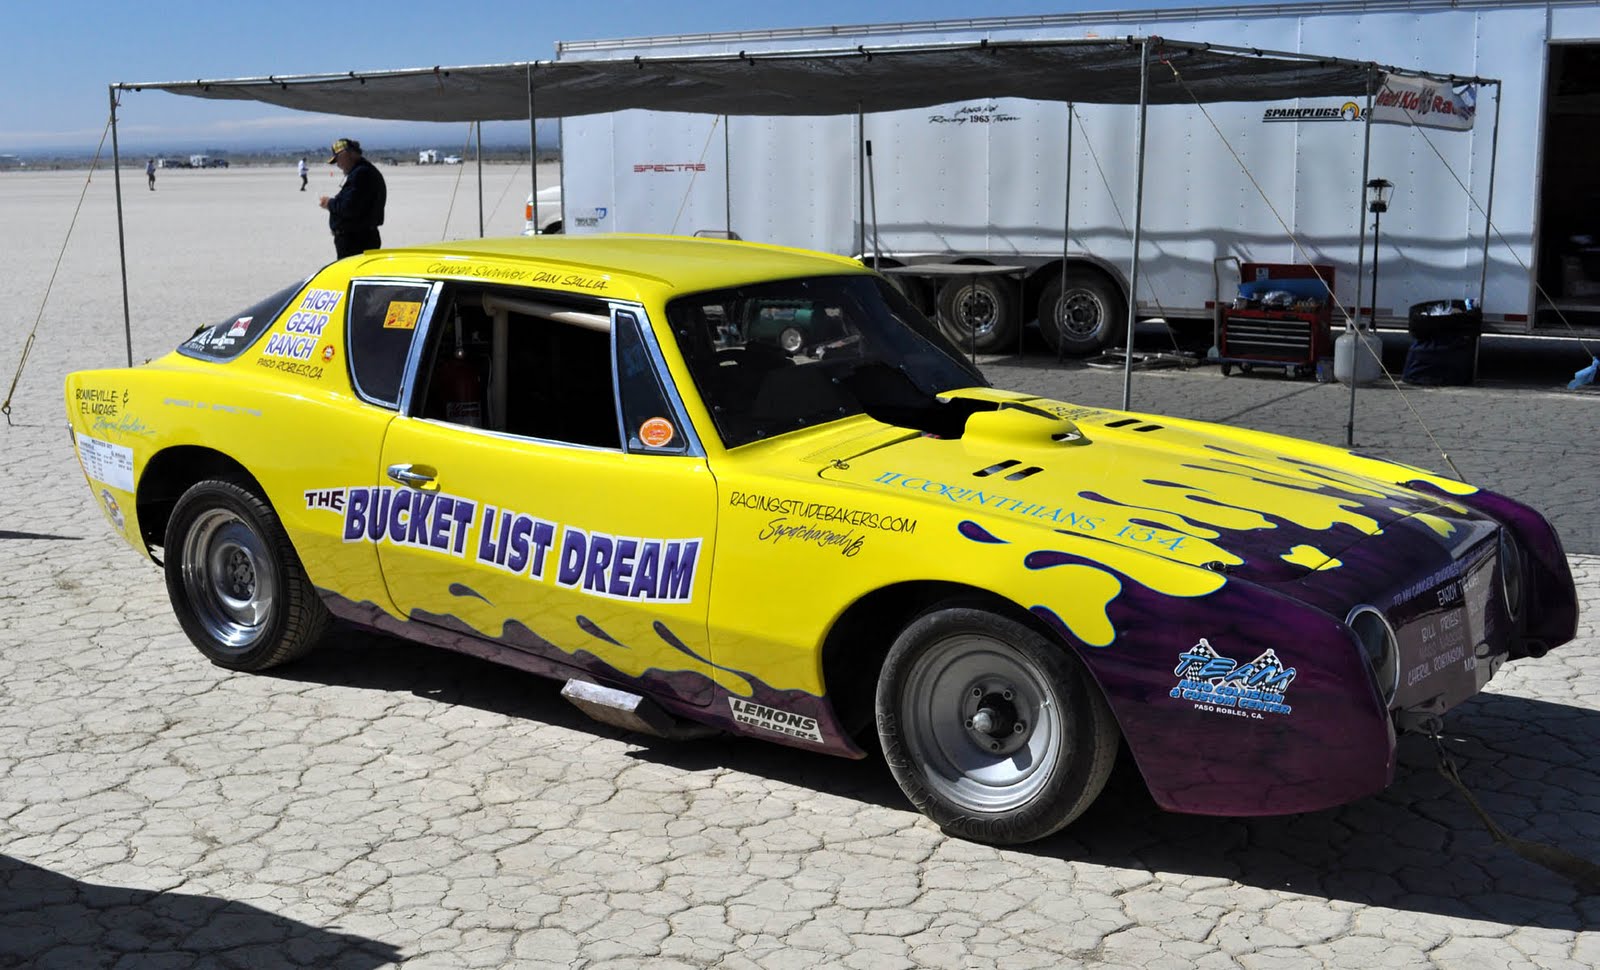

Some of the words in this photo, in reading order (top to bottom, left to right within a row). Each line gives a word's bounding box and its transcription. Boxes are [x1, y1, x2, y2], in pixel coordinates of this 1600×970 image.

[969, 115, 990, 123] 1963
[1263, 108, 1340, 117] SPARKPLUGS
[633, 164, 706, 172] SPECTRE
[532, 271, 562, 285] DAN
[300, 288, 343, 313] HIGH
[285, 311, 328, 336] GEAR
[263, 333, 318, 360] RANCH
[75, 388, 119, 403] BONNEVILLE
[81, 402, 90, 415] EL
[91, 402, 118, 417] MIRAGE
[729, 491, 918, 535] RACINGSTUDEBAKERS.COM
[900, 476, 1106, 531] CORINTHIANS
[304, 490, 345, 513] THE
[343, 487, 477, 557] BUCKET
[477, 505, 557, 580] LIST
[557, 527, 701, 601] DREAM
[758, 517, 856, 548] Supercharged
[1174, 652, 1297, 692] TEAM
[1179, 679, 1214, 693] AUTO
[1215, 685, 1285, 704] COLLISION
[1182, 688, 1237, 708] CUSTOM
[1238, 697, 1292, 715] CENTER
[732, 700, 817, 731] LEMONS
[1194, 703, 1215, 712] PASO
[736, 714, 819, 741] HEADERS
